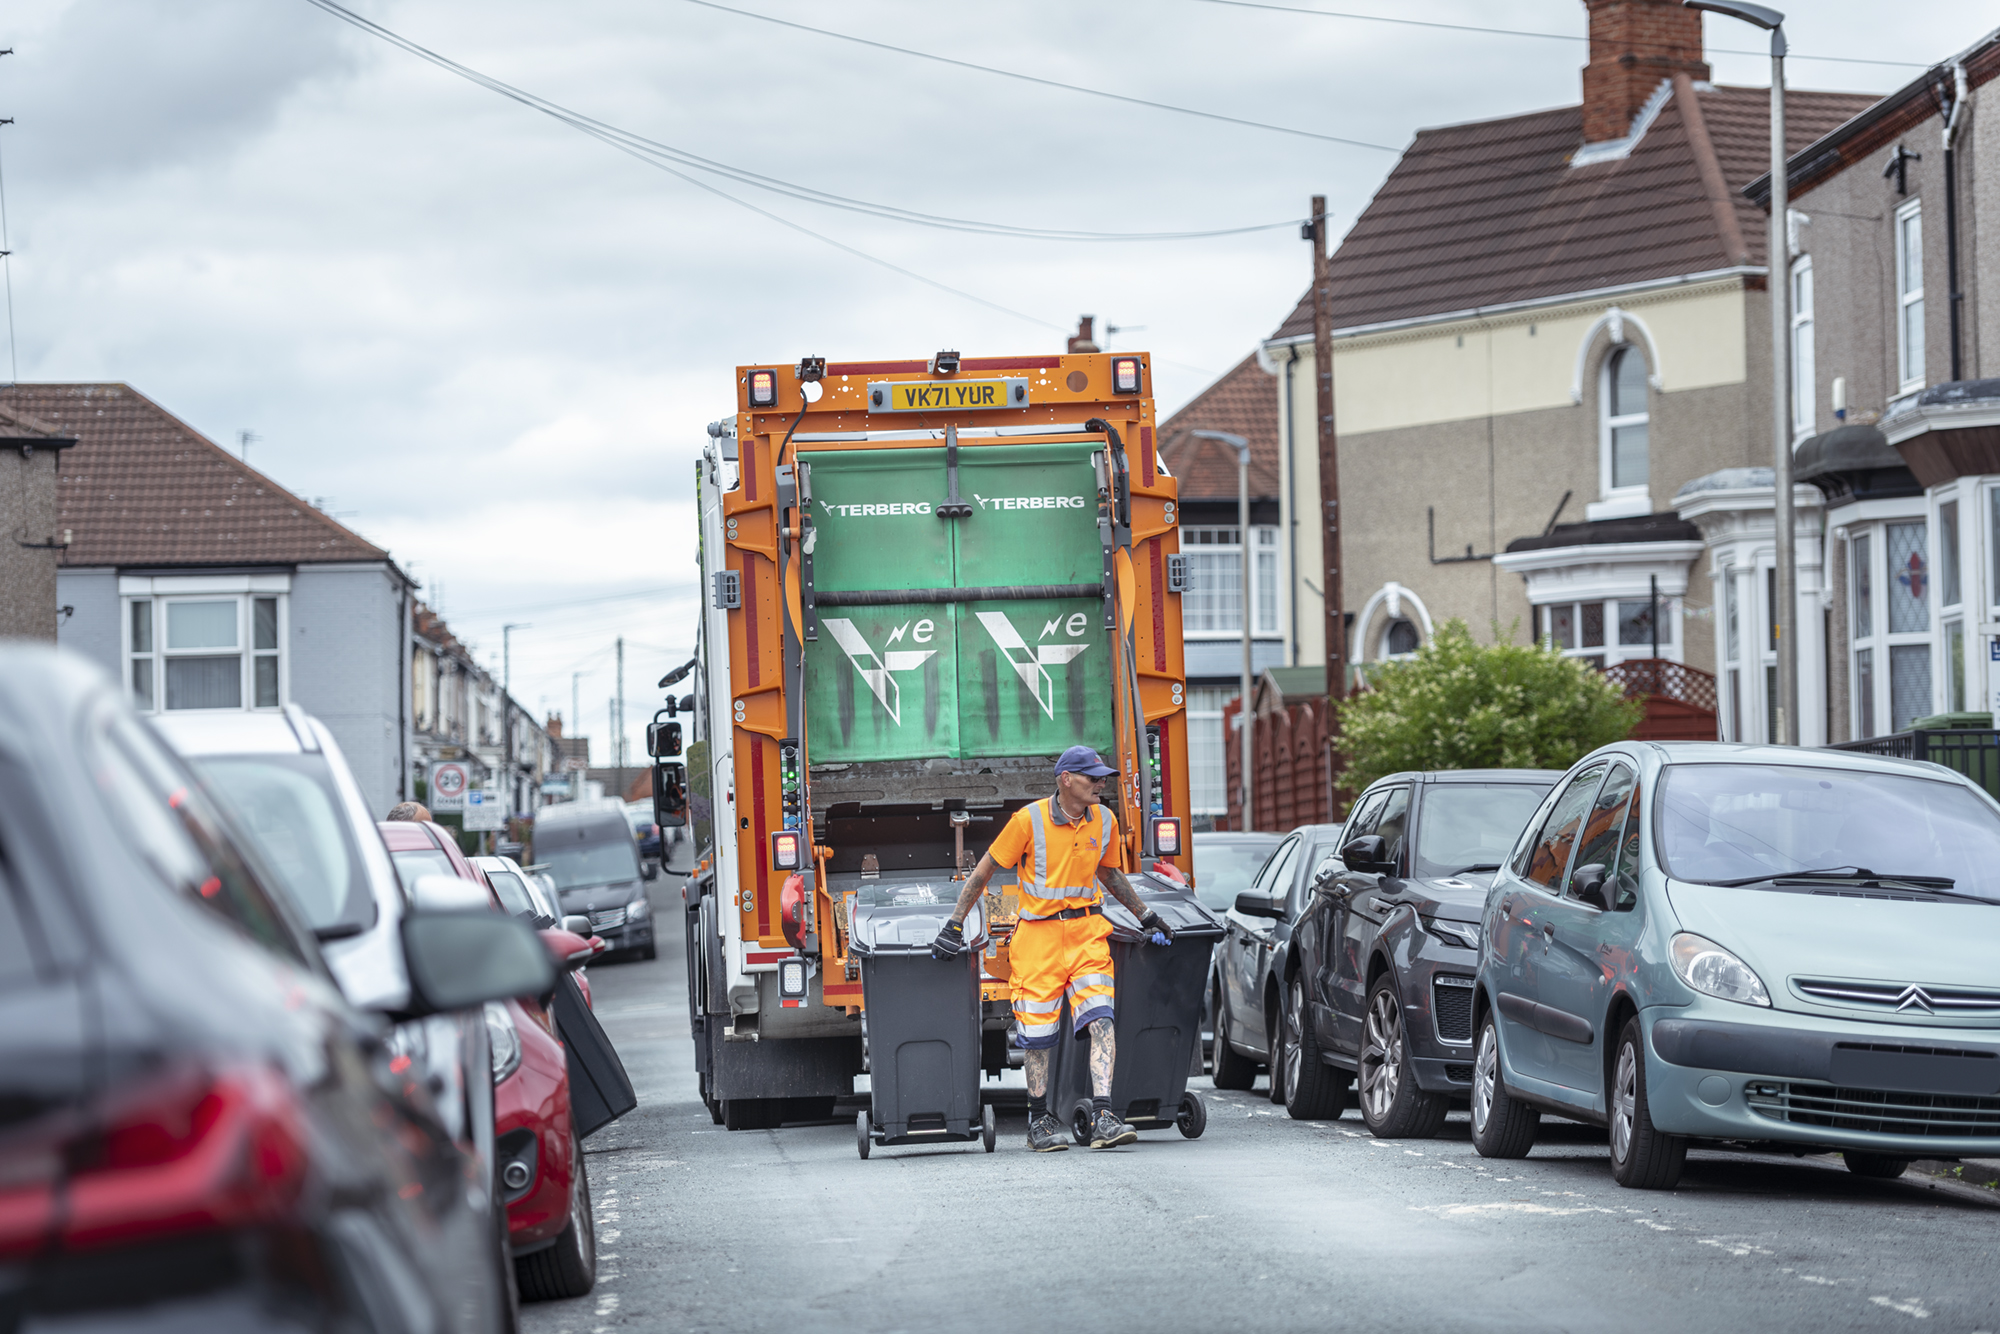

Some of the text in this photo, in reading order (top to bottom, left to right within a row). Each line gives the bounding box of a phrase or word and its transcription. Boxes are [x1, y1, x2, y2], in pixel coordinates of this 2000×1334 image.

[905, 385, 995, 407] VK71 YUR
[836, 502, 931, 517] TERBERG
[989, 496, 1085, 510] TERBERG
[912, 618, 935, 643] e
[1065, 612, 1088, 637] e
[440, 773, 462, 788] 20
